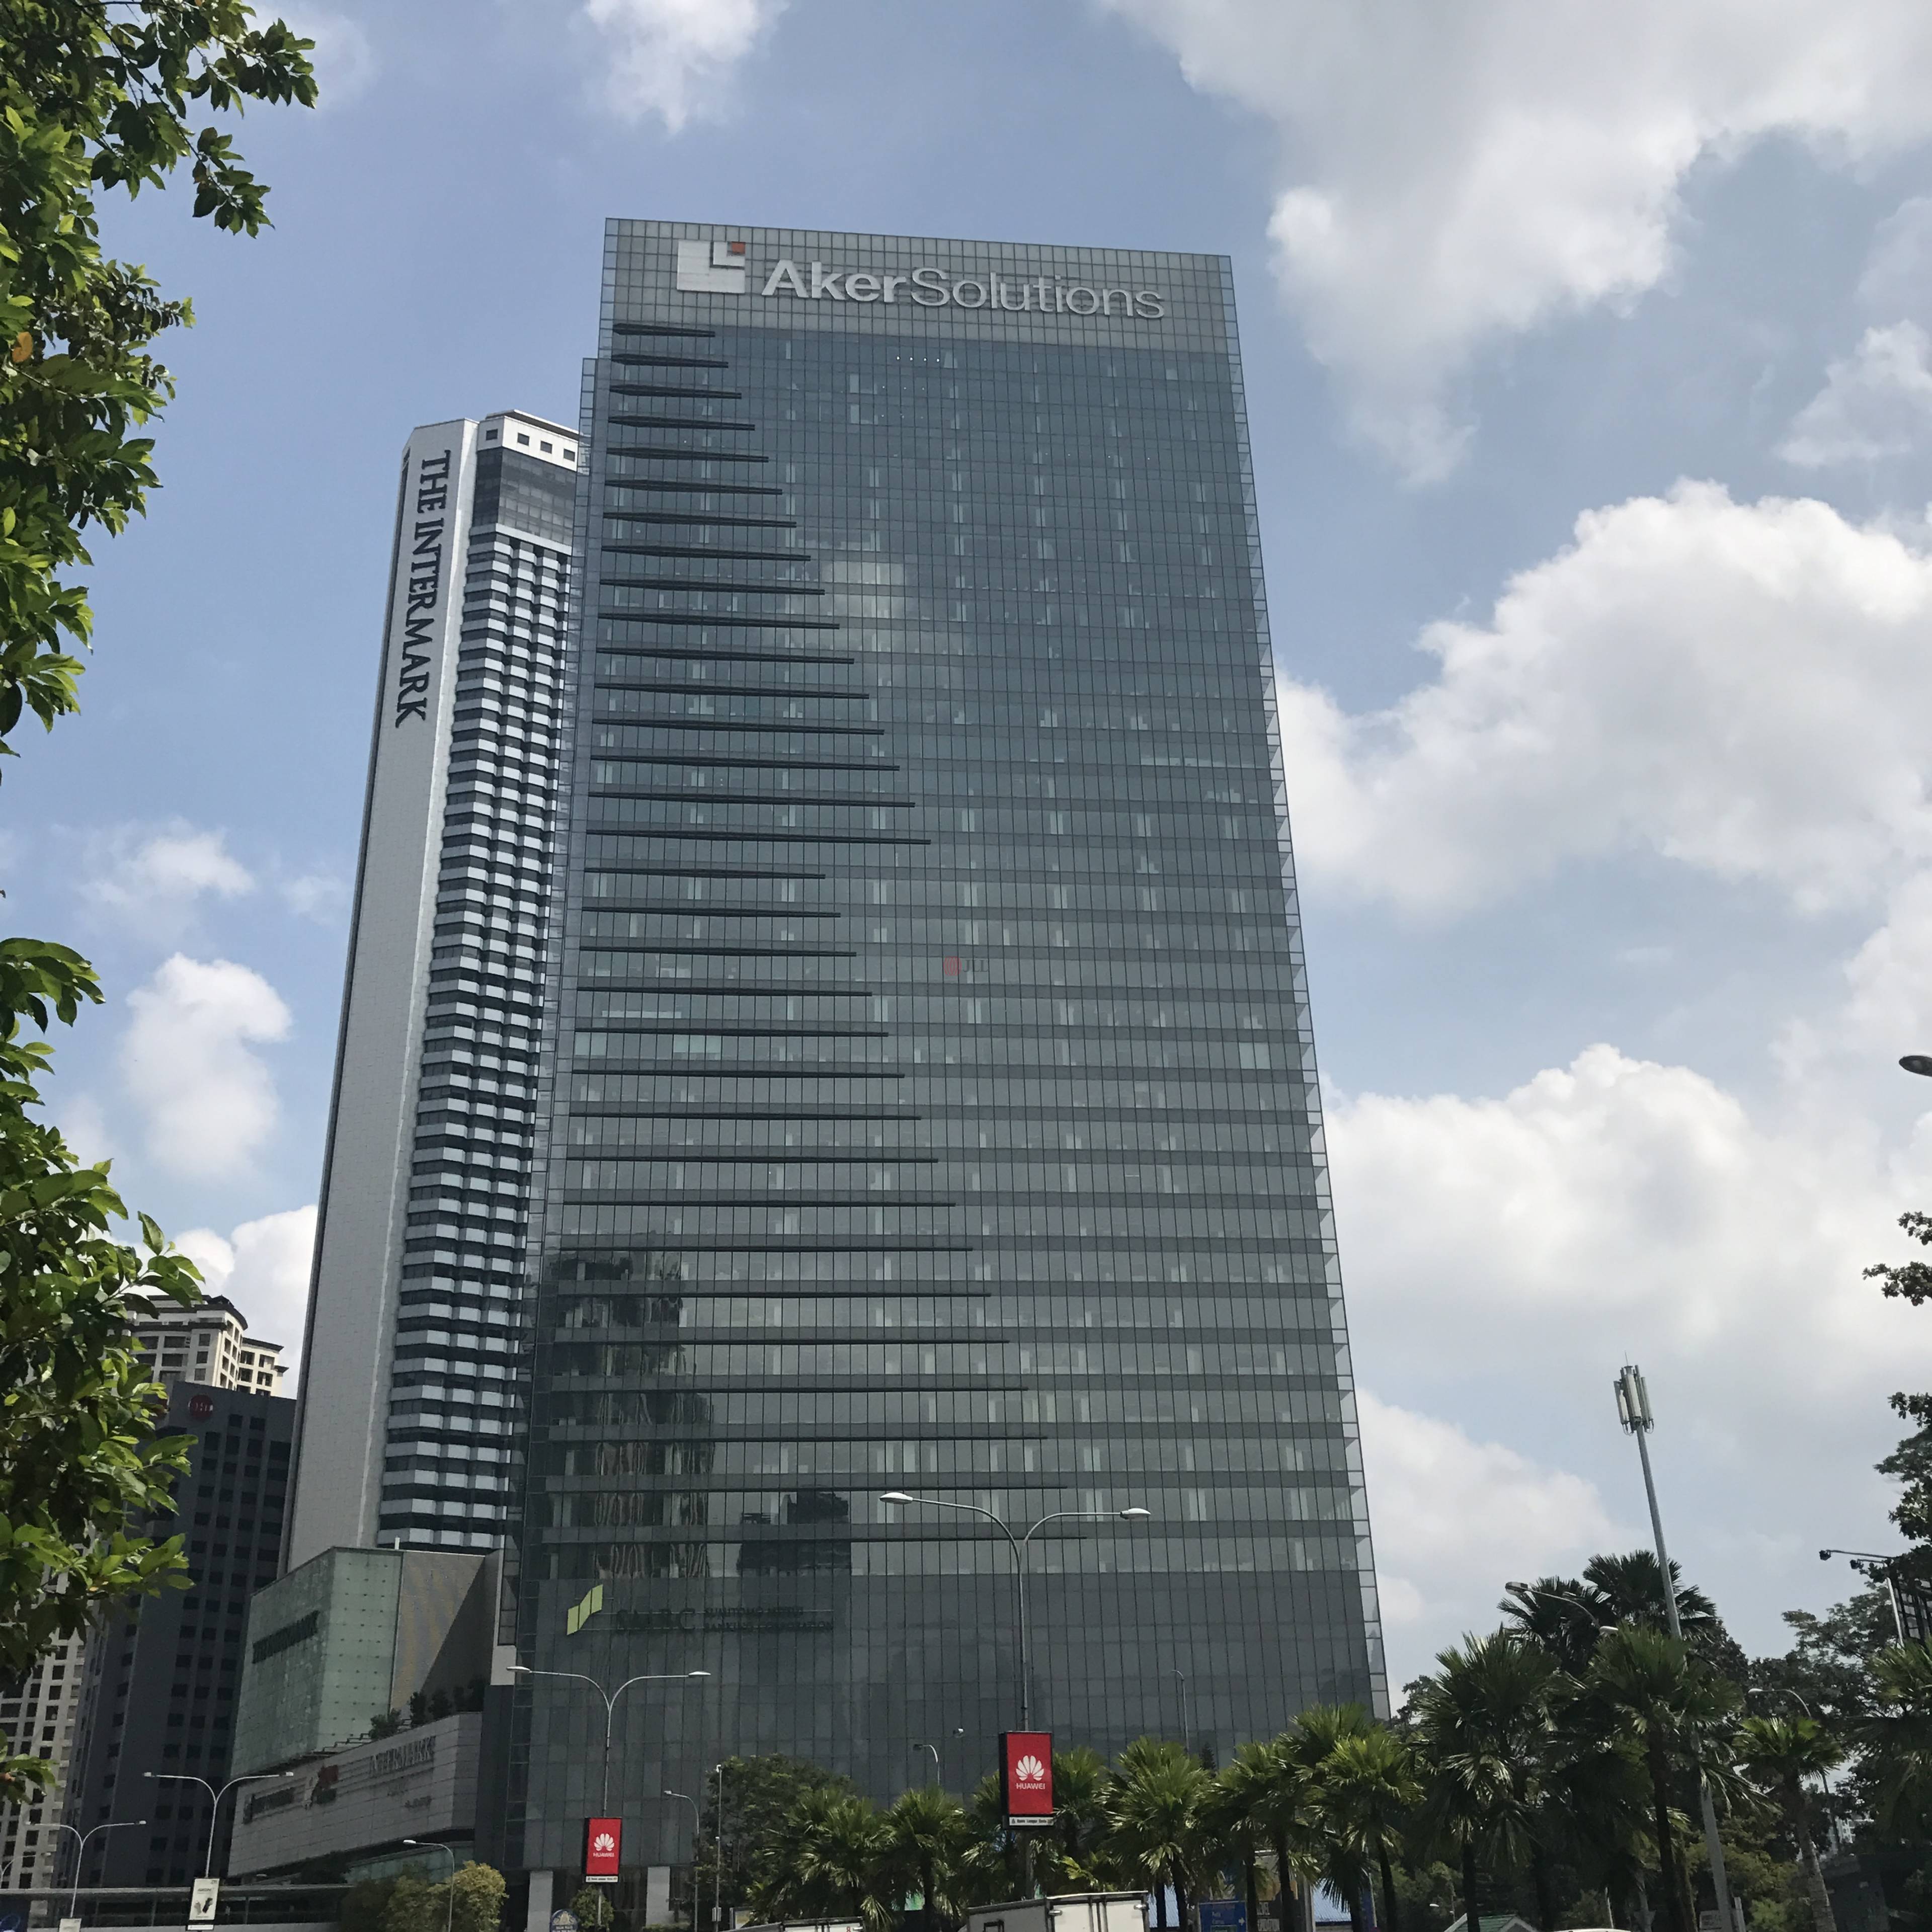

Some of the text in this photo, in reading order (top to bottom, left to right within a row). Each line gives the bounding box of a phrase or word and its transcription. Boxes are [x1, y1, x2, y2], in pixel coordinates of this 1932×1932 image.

[761, 259, 1165, 319] AkerSolutions
[395, 450, 451, 728] THE INTERMARK
